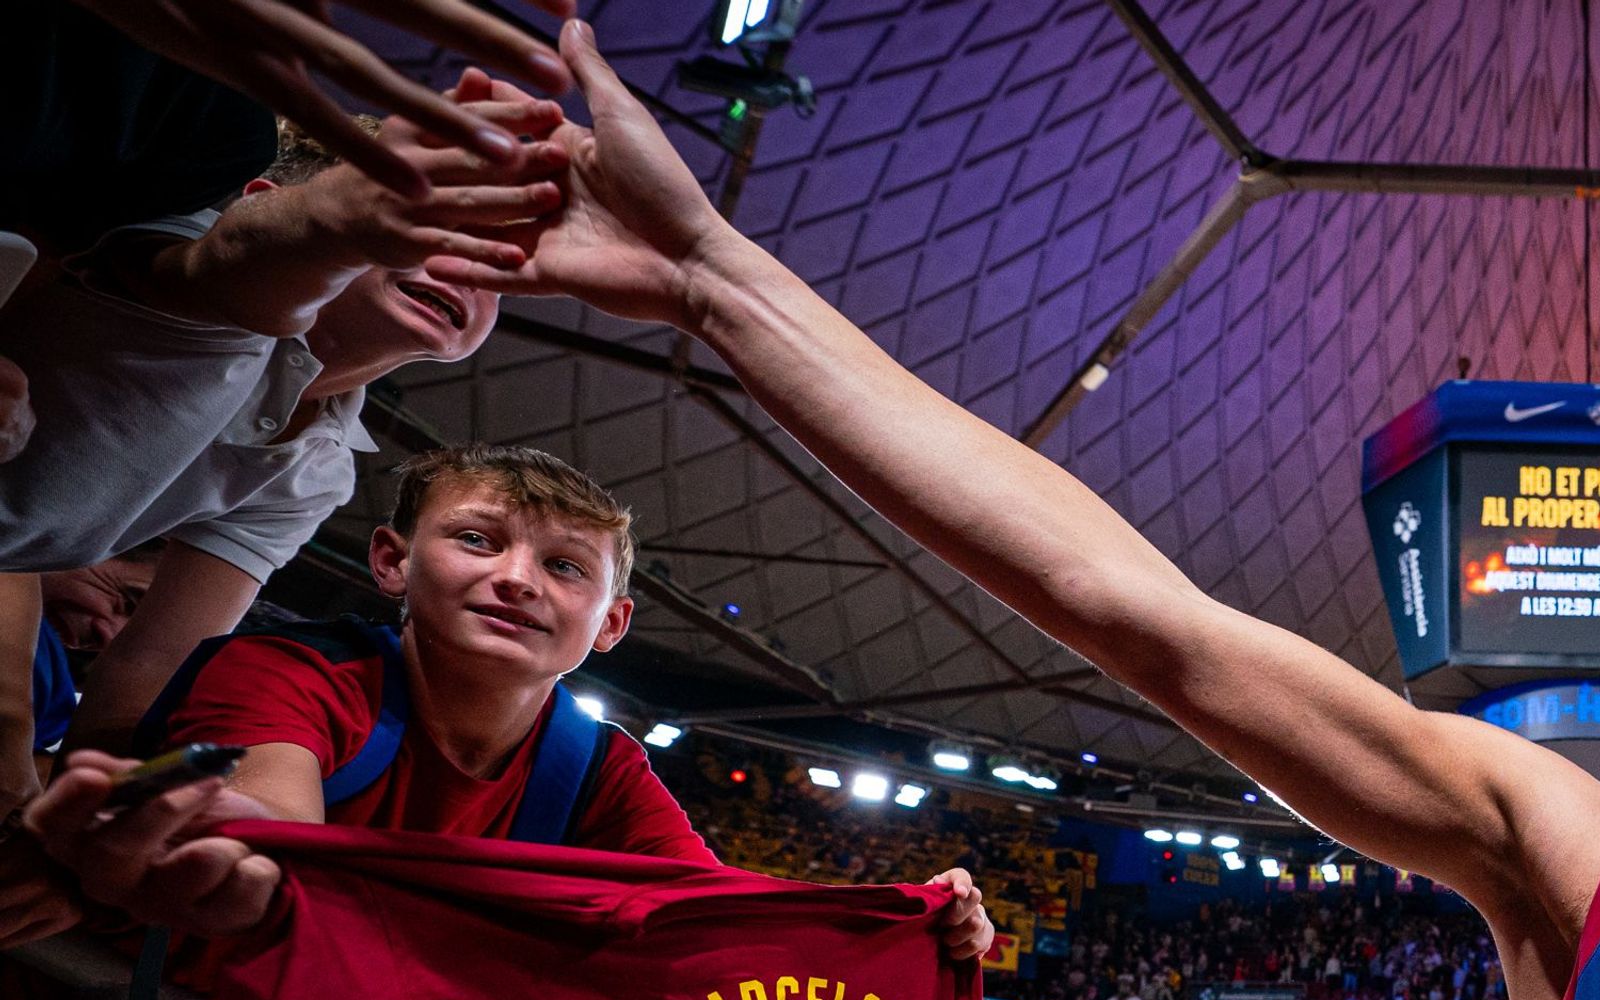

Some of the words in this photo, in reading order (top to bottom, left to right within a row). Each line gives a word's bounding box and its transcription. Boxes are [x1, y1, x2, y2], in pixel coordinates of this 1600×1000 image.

[1519, 466, 1551, 496] NO
[1555, 467, 1581, 497] ET
[1481, 496, 1509, 527] AL
[1513, 498, 1600, 529] PROPER
[1521, 596, 1532, 615] A
[1532, 596, 1557, 615] LES
